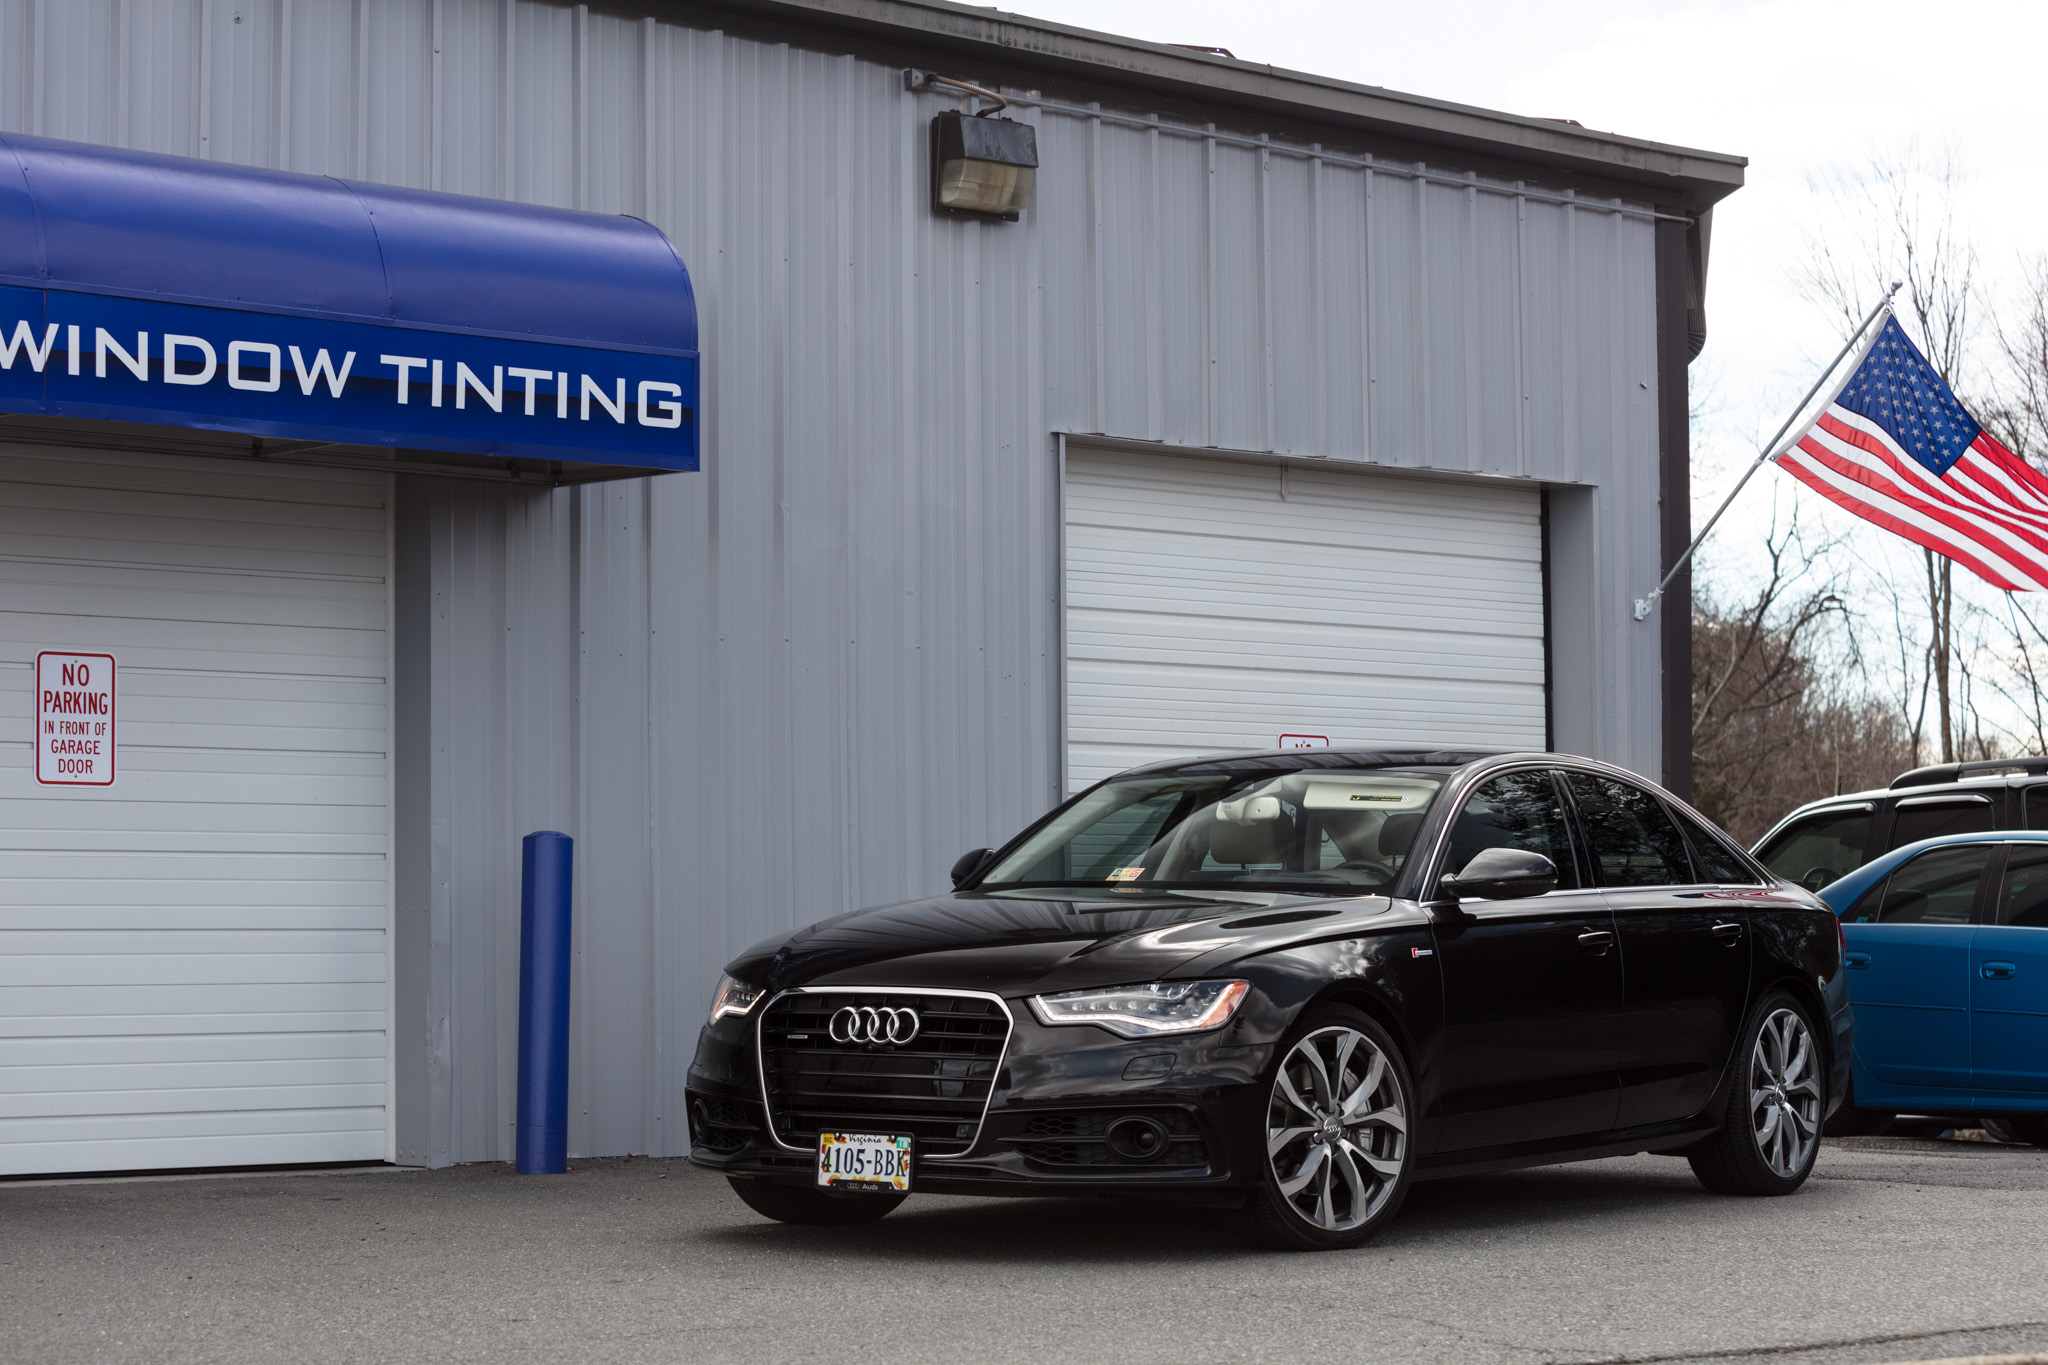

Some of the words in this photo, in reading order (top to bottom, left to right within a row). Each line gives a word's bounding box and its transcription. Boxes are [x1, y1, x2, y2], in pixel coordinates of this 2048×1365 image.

[0, 320, 356, 398] WINDOW
[380, 354, 683, 429] TINTING
[62, 663, 90, 687] NO
[43, 690, 108, 715] PARKING
[44, 720, 54, 734] IN
[59, 721, 90, 735] FRONT
[94, 722, 107, 736] OF
[51, 739, 100, 755] GARAGE
[58, 759, 93, 774] DOOR
[849, 1134, 881, 1145] Virginia
[822, 1146, 907, 1177] 4105-BBK
